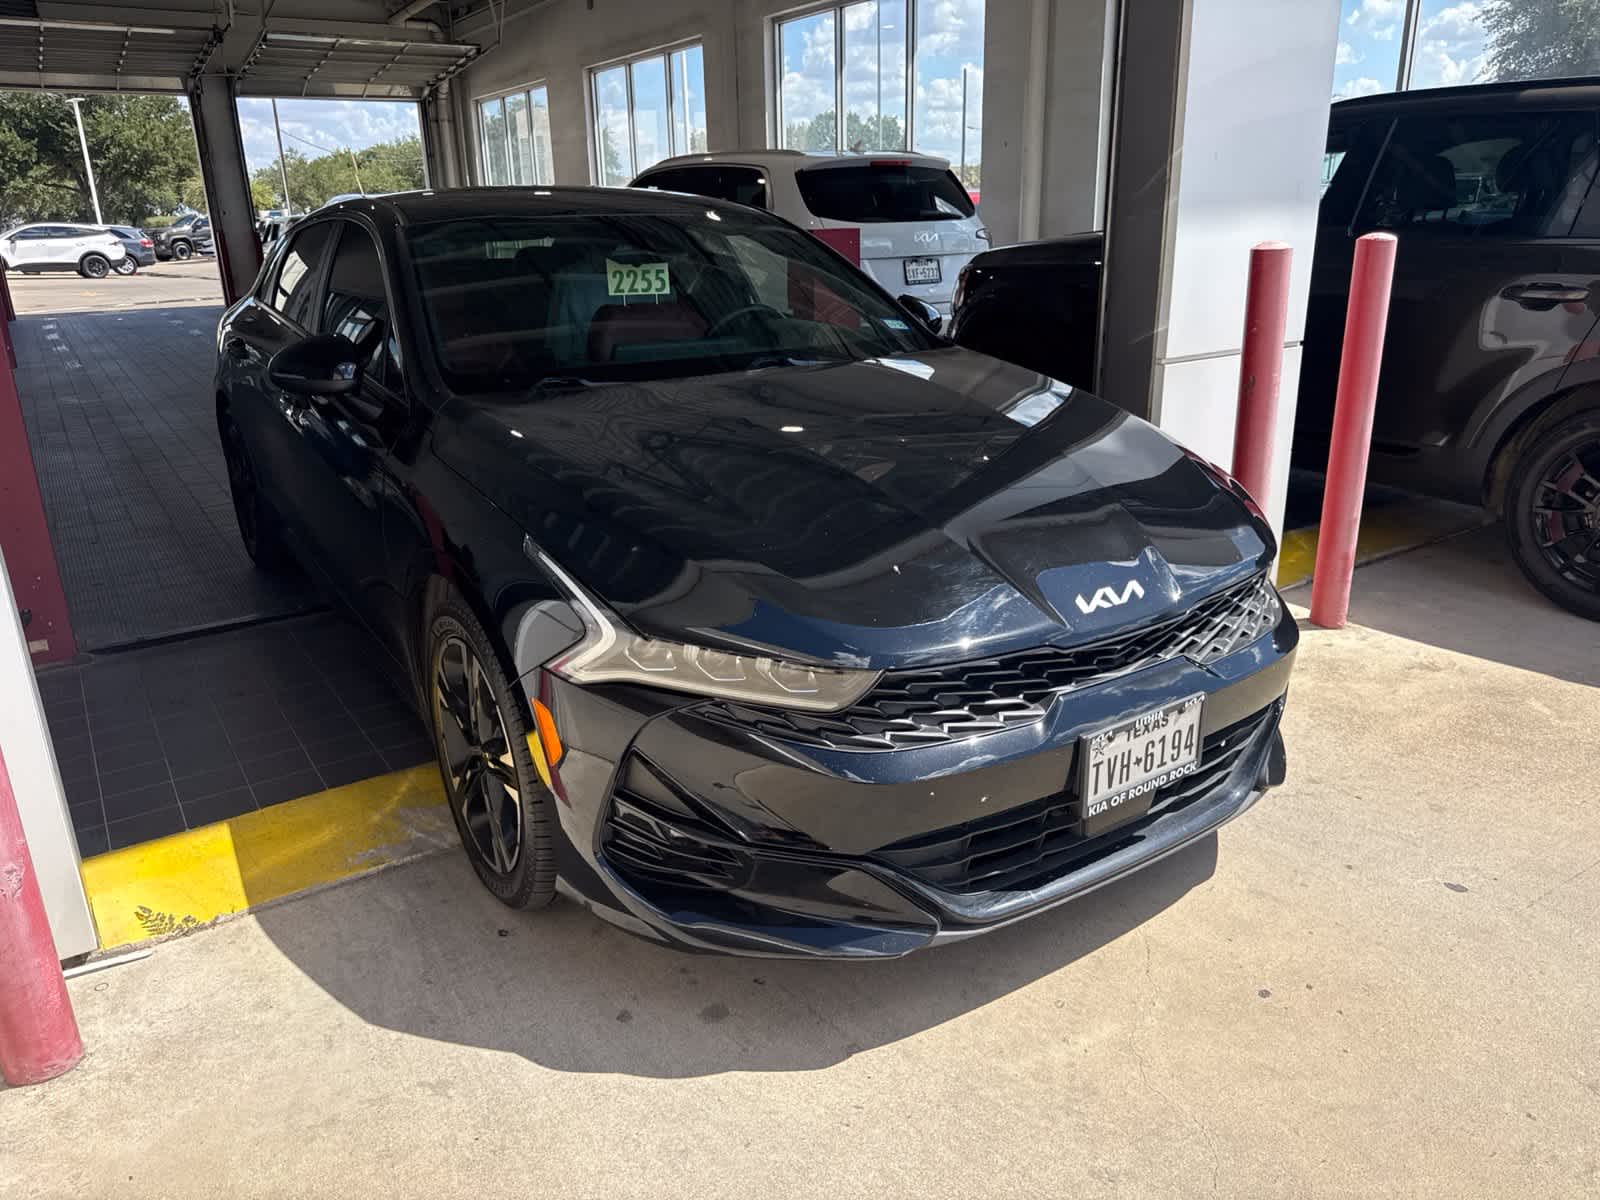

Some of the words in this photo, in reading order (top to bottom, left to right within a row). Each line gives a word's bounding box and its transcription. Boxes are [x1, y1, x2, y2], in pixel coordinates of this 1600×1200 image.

[611, 269, 666, 293] 2255
[1074, 579, 1145, 614] KIA
[1125, 713, 1169, 742] TEXAS
[1135, 710, 1163, 728] LITHIA
[1088, 802, 1108, 817] KIA
[1110, 794, 1126, 808] OF
[1128, 775, 1167, 800] ROUND
[1169, 760, 1198, 781] ROCK
